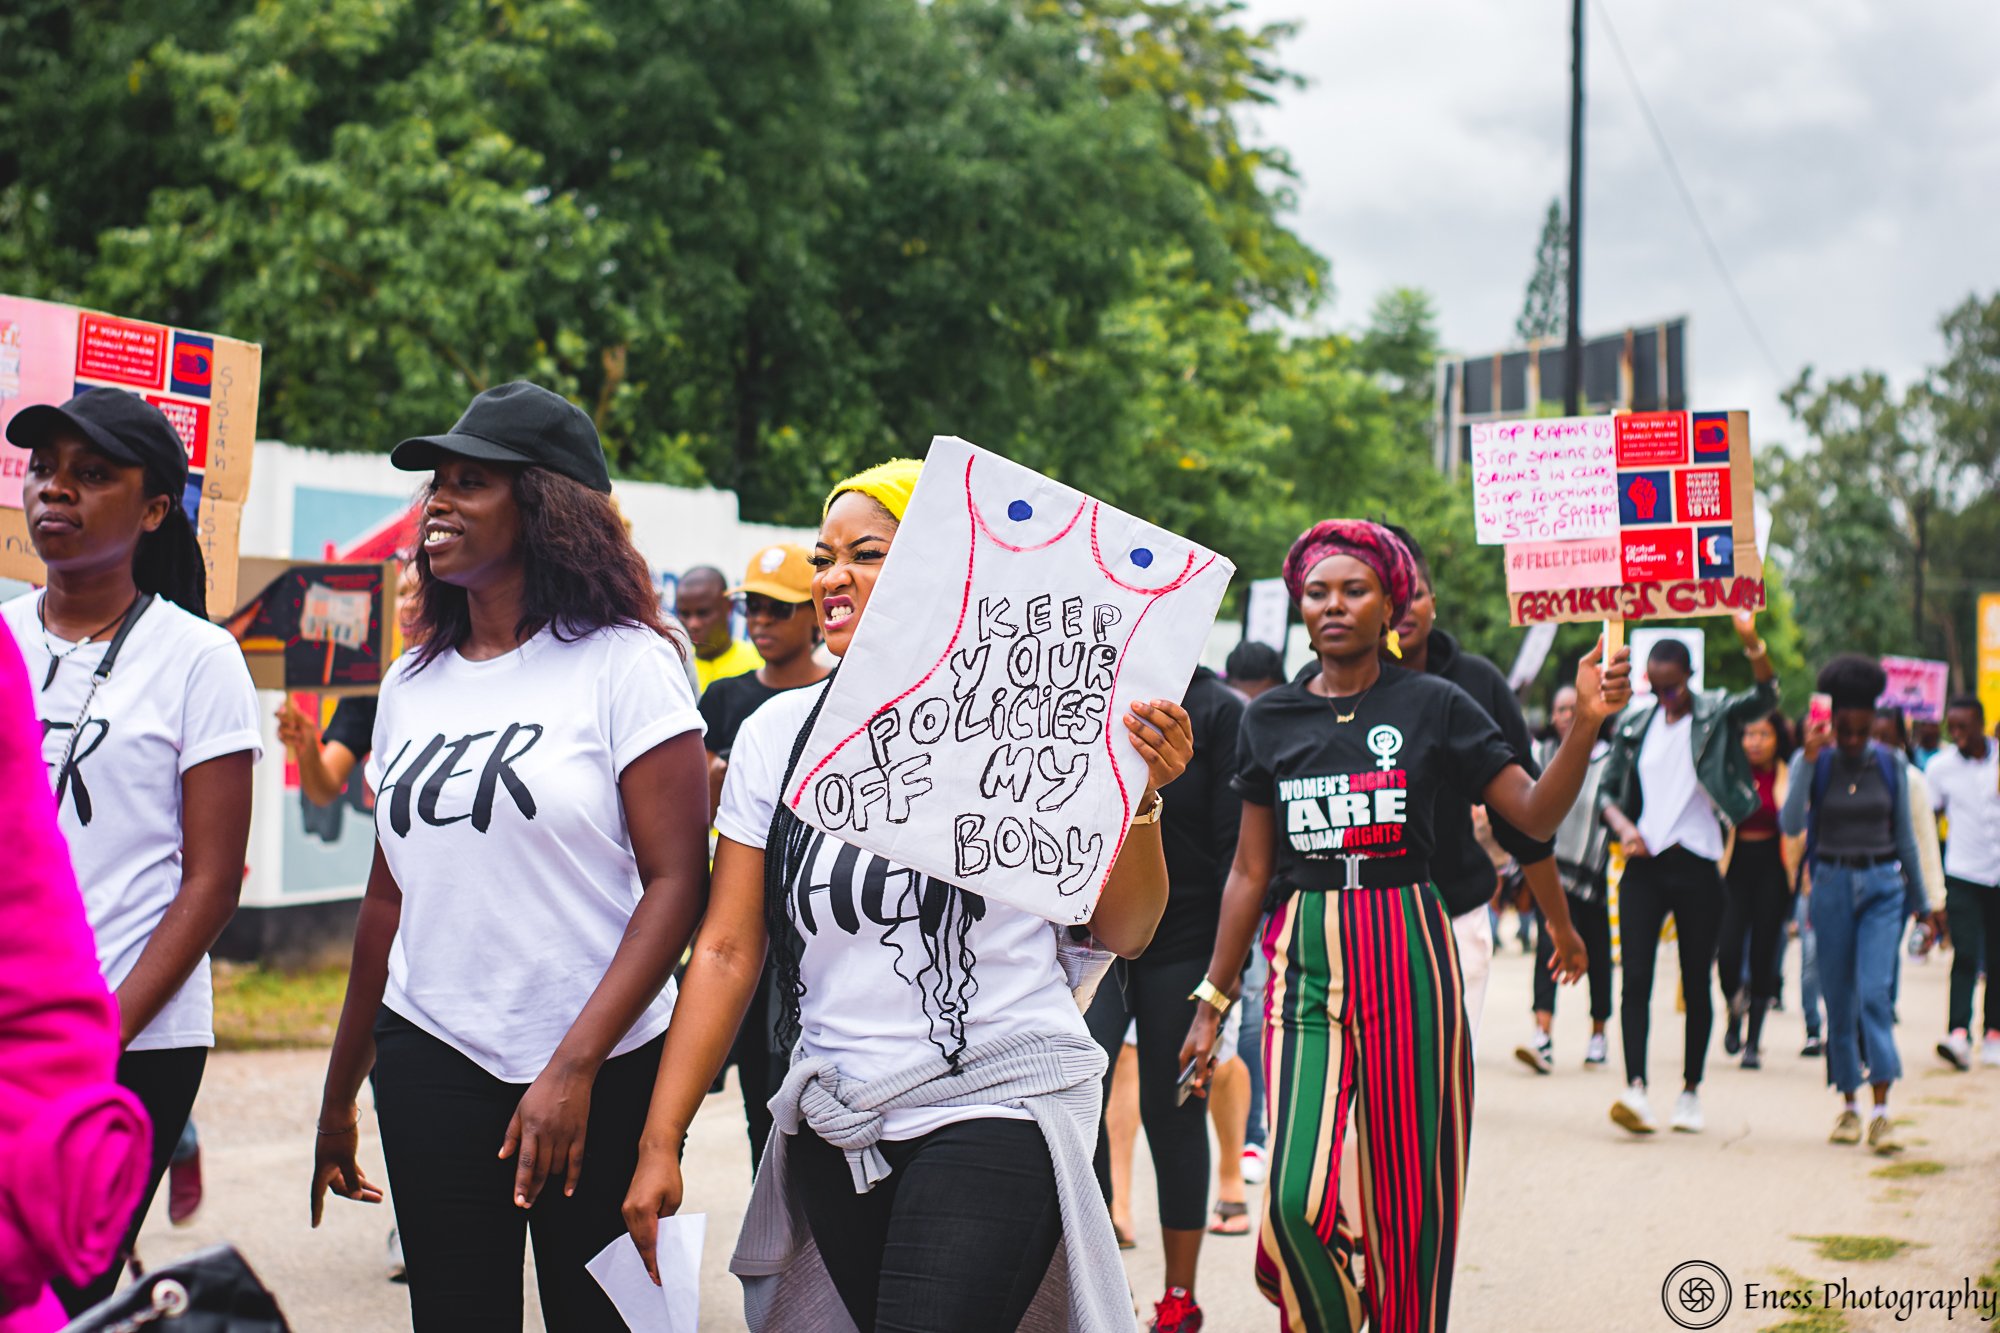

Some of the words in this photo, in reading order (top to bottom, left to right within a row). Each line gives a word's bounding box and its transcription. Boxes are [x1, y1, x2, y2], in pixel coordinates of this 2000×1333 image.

[1473, 425, 1524, 443] STOP
[1594, 423, 1611, 439] US
[1632, 421, 1649, 430] YOU
[1650, 420, 1665, 430] PAY
[1476, 449, 1518, 468] STOP
[1551, 471, 1565, 481] IN
[1478, 490, 1522, 505] STOP
[1625, 544, 1656, 554] Global
[1625, 553, 1667, 563] Platform
[977, 592, 1123, 644] KEEP
[950, 634, 1118, 701] YOUR
[374, 721, 544, 839] HER
[814, 752, 934, 832] OFF
[979, 743, 1090, 813] MY
[1349, 769, 1408, 793] RIGHTS
[1287, 788, 1408, 833] ARE
[1343, 823, 1404, 848] RIGHTS
[954, 812, 1104, 897] BODY
